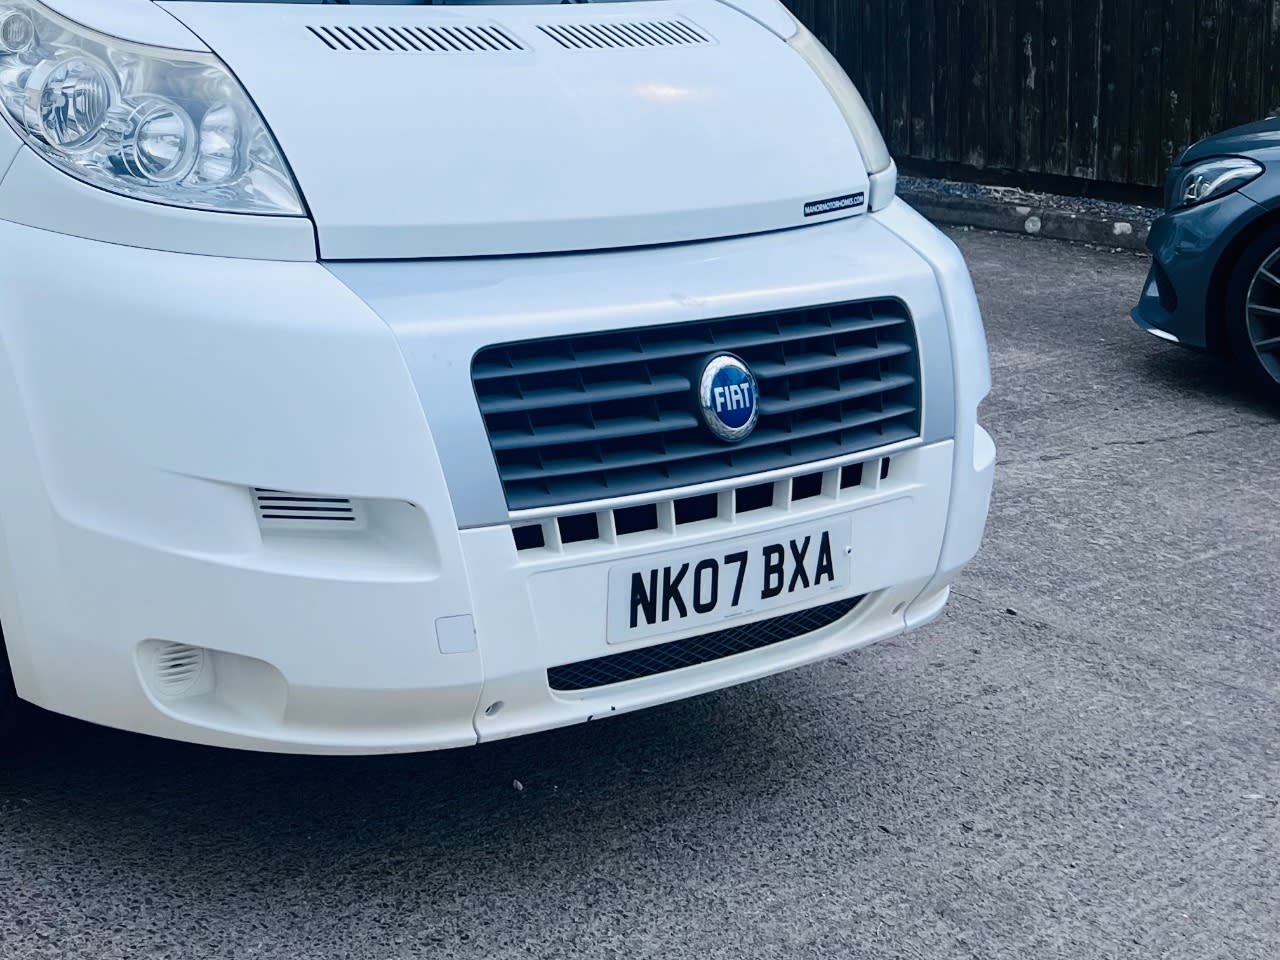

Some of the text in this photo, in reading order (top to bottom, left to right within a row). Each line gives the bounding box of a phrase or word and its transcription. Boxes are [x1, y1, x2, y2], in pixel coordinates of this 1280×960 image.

[714, 383, 750, 412] FIAT
[630, 531, 835, 628] NK07 BXA
